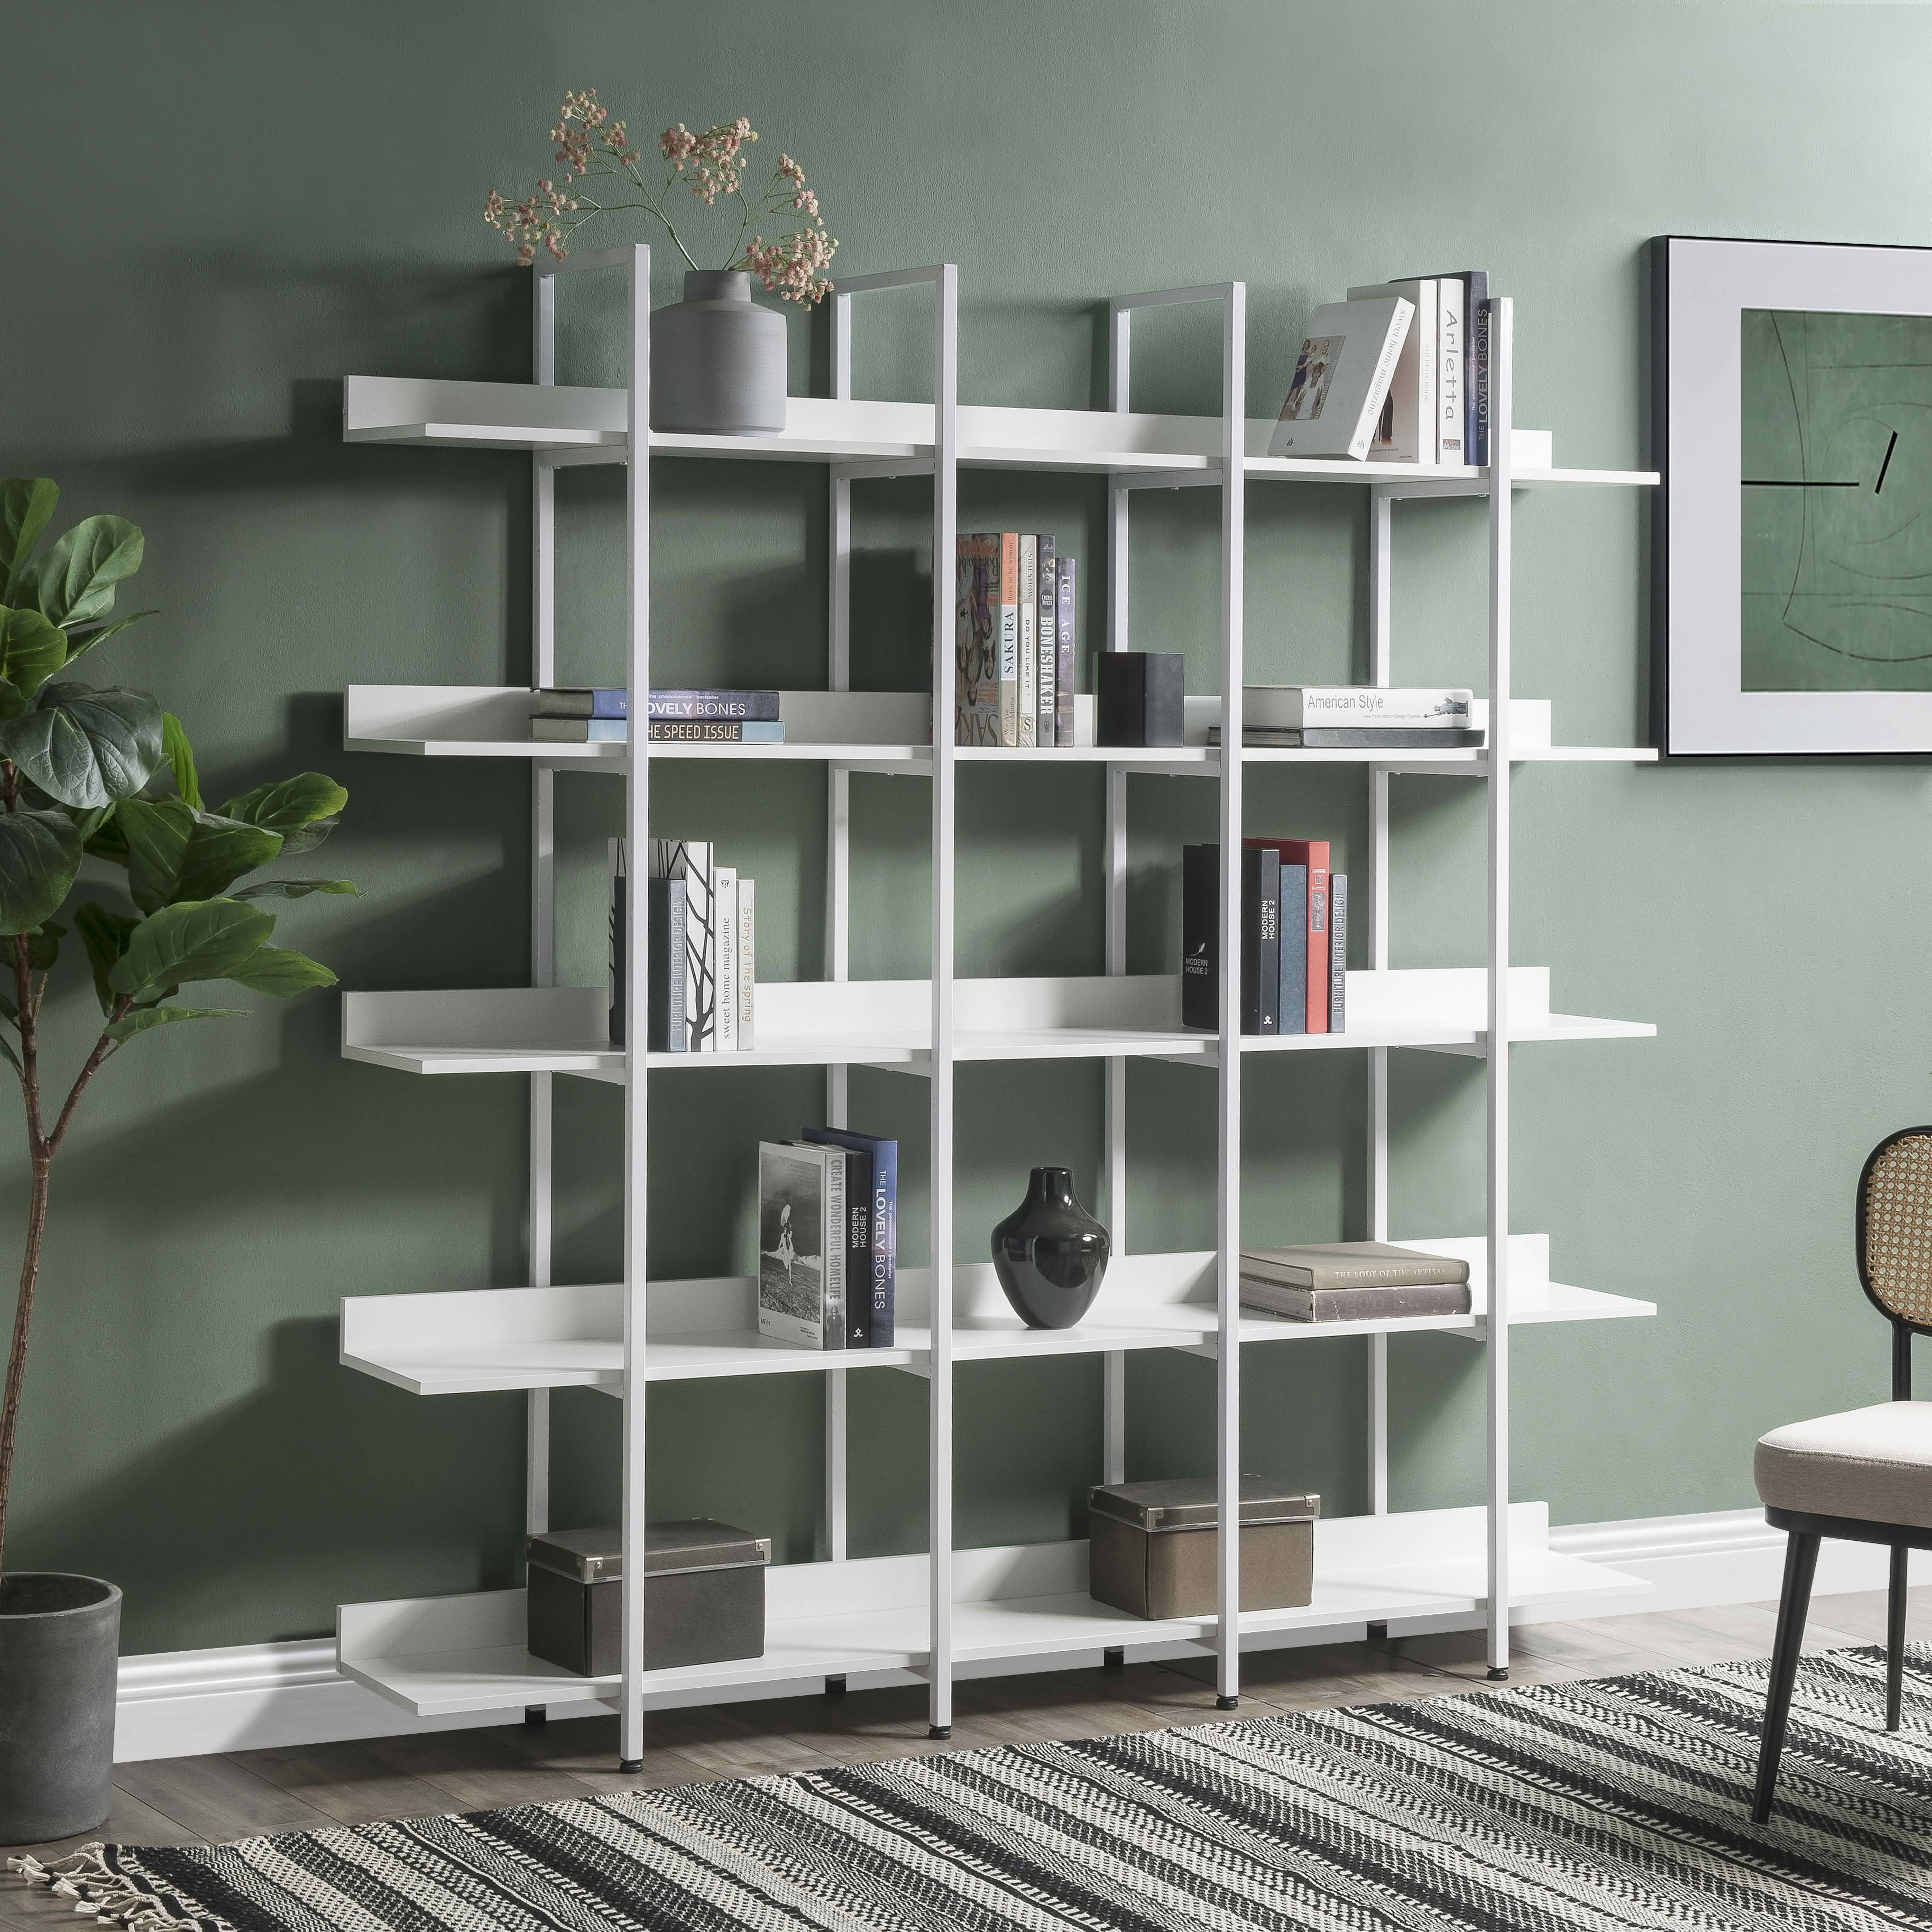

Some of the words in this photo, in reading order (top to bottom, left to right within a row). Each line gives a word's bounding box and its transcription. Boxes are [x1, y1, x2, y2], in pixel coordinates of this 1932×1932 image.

[1393, 309, 1406, 337] sweet
[1478, 308, 1487, 361] BONES
[1383, 339, 1397, 366] home
[1446, 309, 1458, 420] Arletta
[1368, 369, 1387, 416] magazine
[1478, 365, 1488, 423] LOVELY
[1062, 575, 1071, 604] ICE
[1004, 612, 1015, 674] SAKURA
[1025, 619, 1030, 632] DO
[1062, 619, 1071, 654] AGE
[1040, 616, 1054, 714] BONESHAKER
[1025, 679, 1030, 689] IT
[648, 703, 692, 714] OVELY
[697, 703, 746, 715] BONES
[1308, 695, 1355, 709] American
[1359, 695, 1384, 712] Style
[648, 725, 661, 739] HE
[664, 724, 700, 740] SPEED
[703, 725, 739, 740] ISSUE
[1004, 724, 1009, 735] We
[673, 901, 684, 934] DESIGN
[740, 908, 752, 943] Story
[673, 939, 684, 978] INTERIOR
[721, 917, 732, 970] magazine
[743, 945, 752, 958] of
[1335, 926, 1344, 966] INTERIOR
[743, 960, 752, 982] the
[1185, 958, 1208, 967] MODERN
[672, 981, 683, 1031] FURNITURE
[741, 985, 752, 1023] spring
[1334, 967, 1344, 1014] FURNITURE
[831, 1160, 842, 1192] CREATE
[830, 1194, 842, 1252] WONDERFUL
[876, 1188, 886, 1251] LOVELY
[829, 1255, 841, 1299] HOMELIFE
[875, 1255, 886, 1309] BONES
